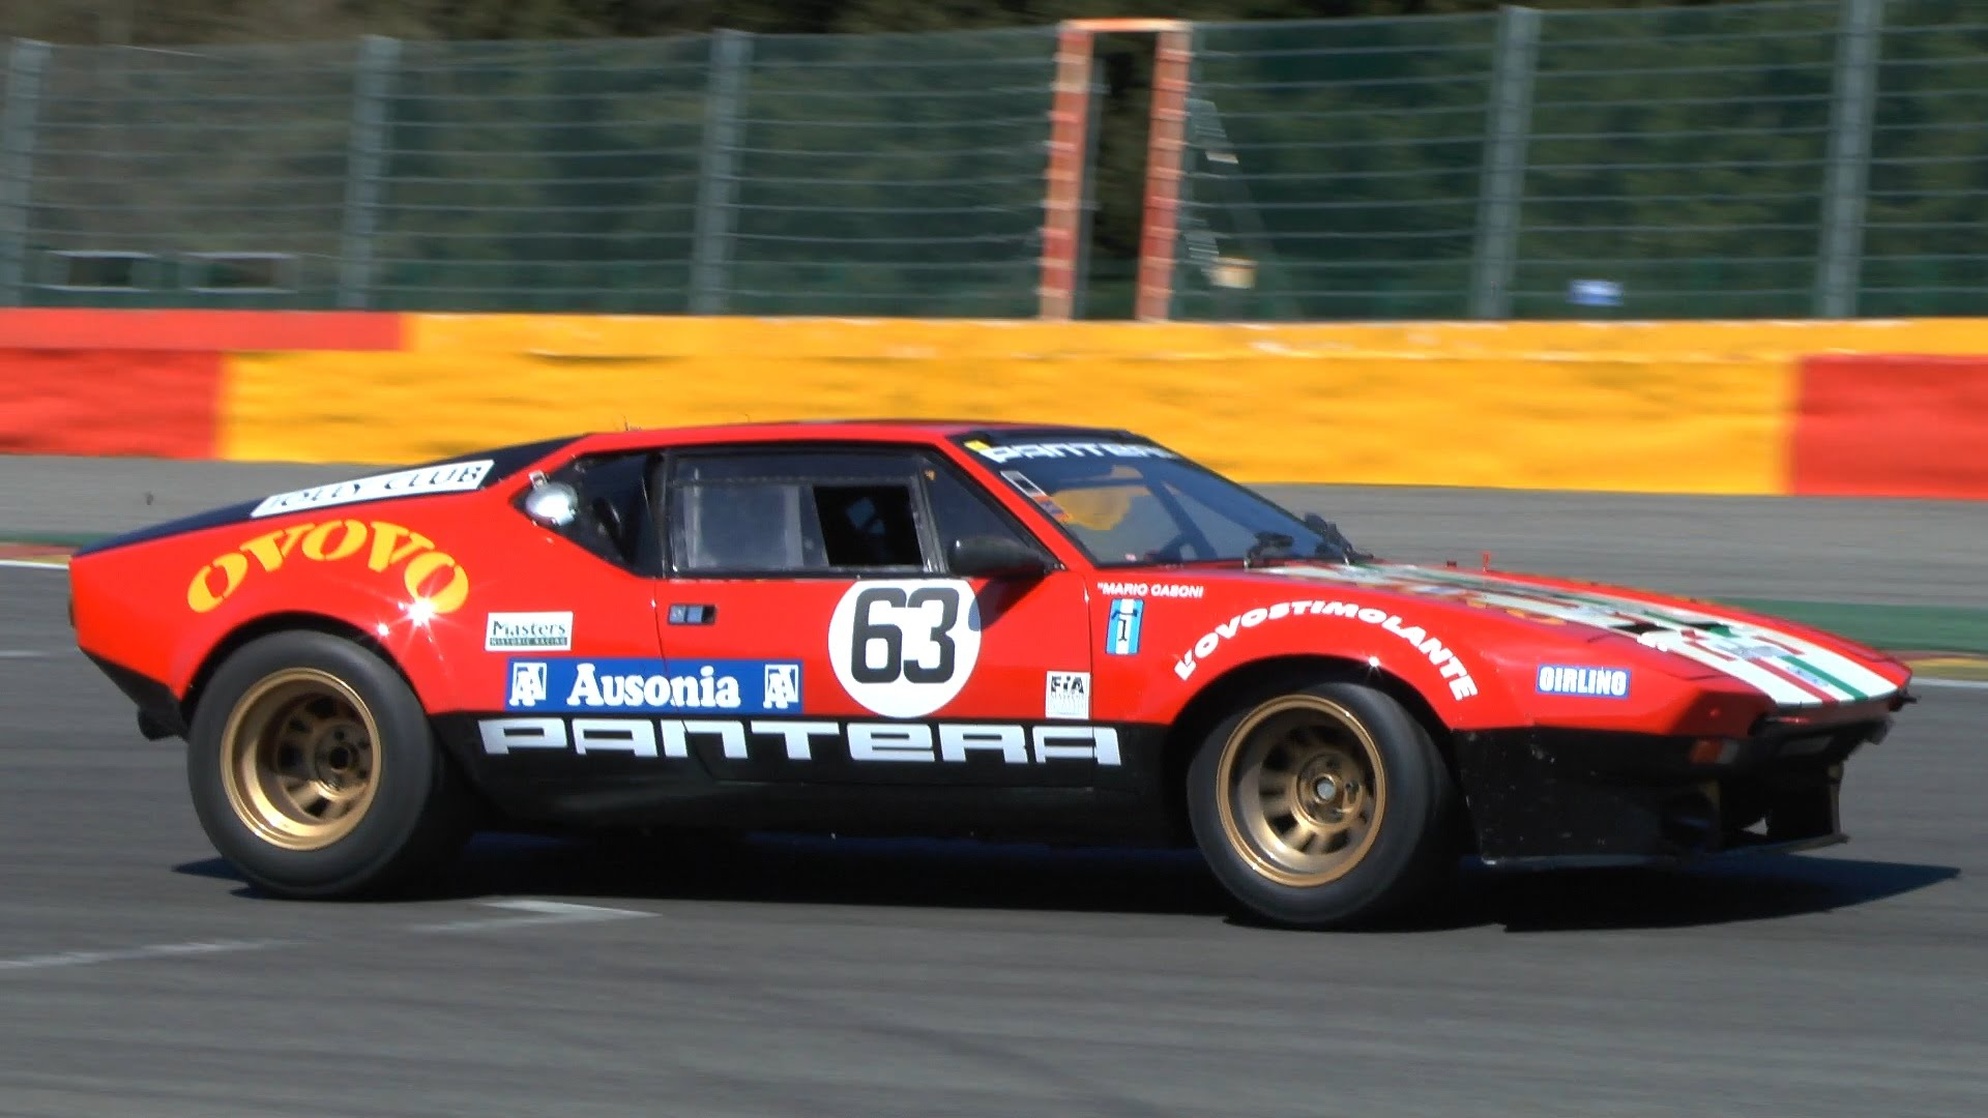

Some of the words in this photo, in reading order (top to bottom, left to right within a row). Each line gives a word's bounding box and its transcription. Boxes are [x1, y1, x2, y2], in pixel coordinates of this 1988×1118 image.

[188, 519, 469, 613] OVOVO
[492, 620, 566, 636] Masters
[851, 588, 960, 684] 63
[566, 663, 741, 708] Ausonia
[478, 718, 1121, 766] PANTERA
